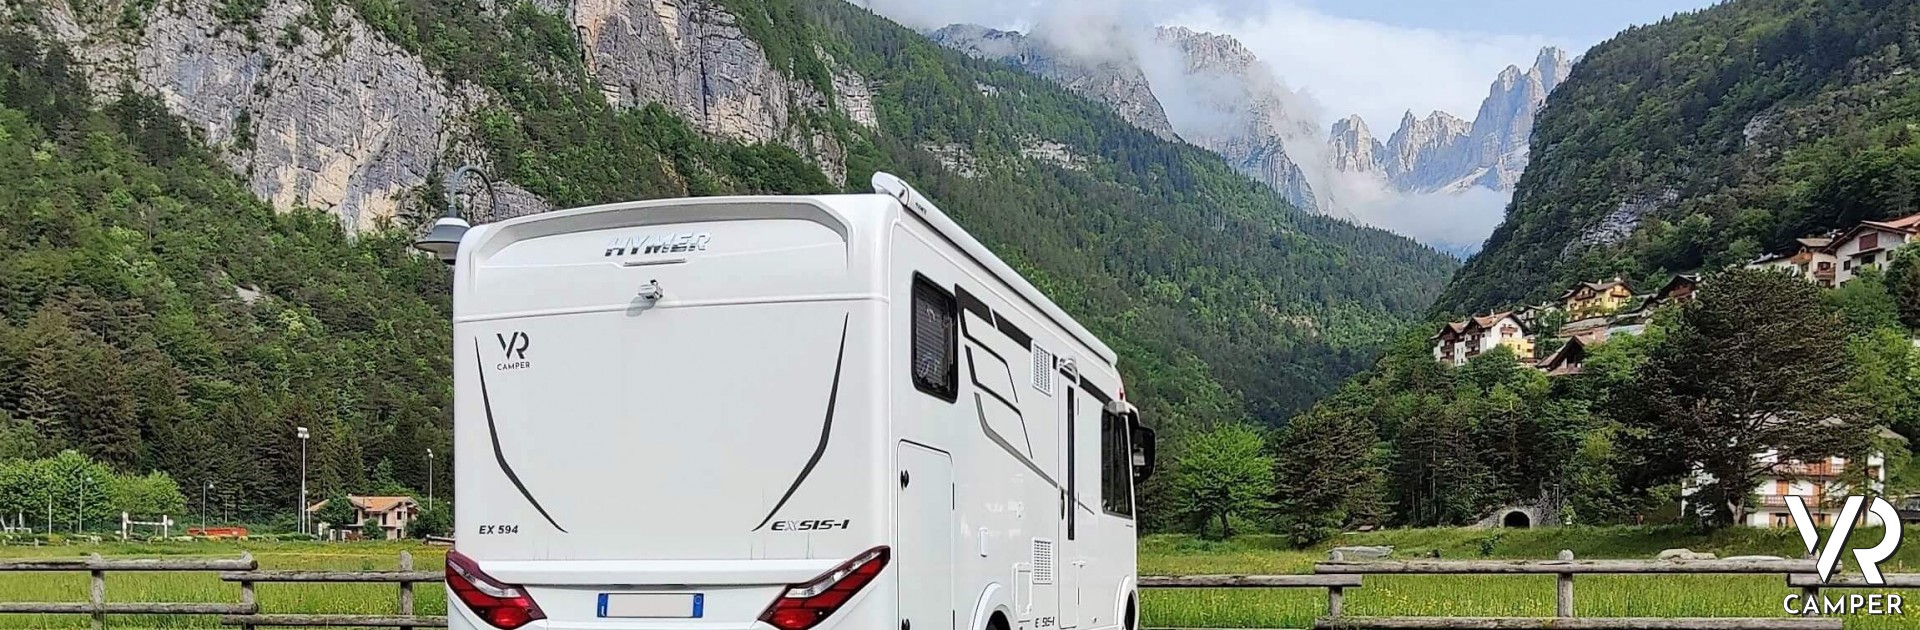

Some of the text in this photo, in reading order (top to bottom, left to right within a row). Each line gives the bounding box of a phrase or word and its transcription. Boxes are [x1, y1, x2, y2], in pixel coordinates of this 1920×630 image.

[605, 232, 711, 257] HYMER
[496, 331, 530, 360] VR
[496, 361, 531, 371] CAMPER
[479, 524, 519, 535] EX 594
